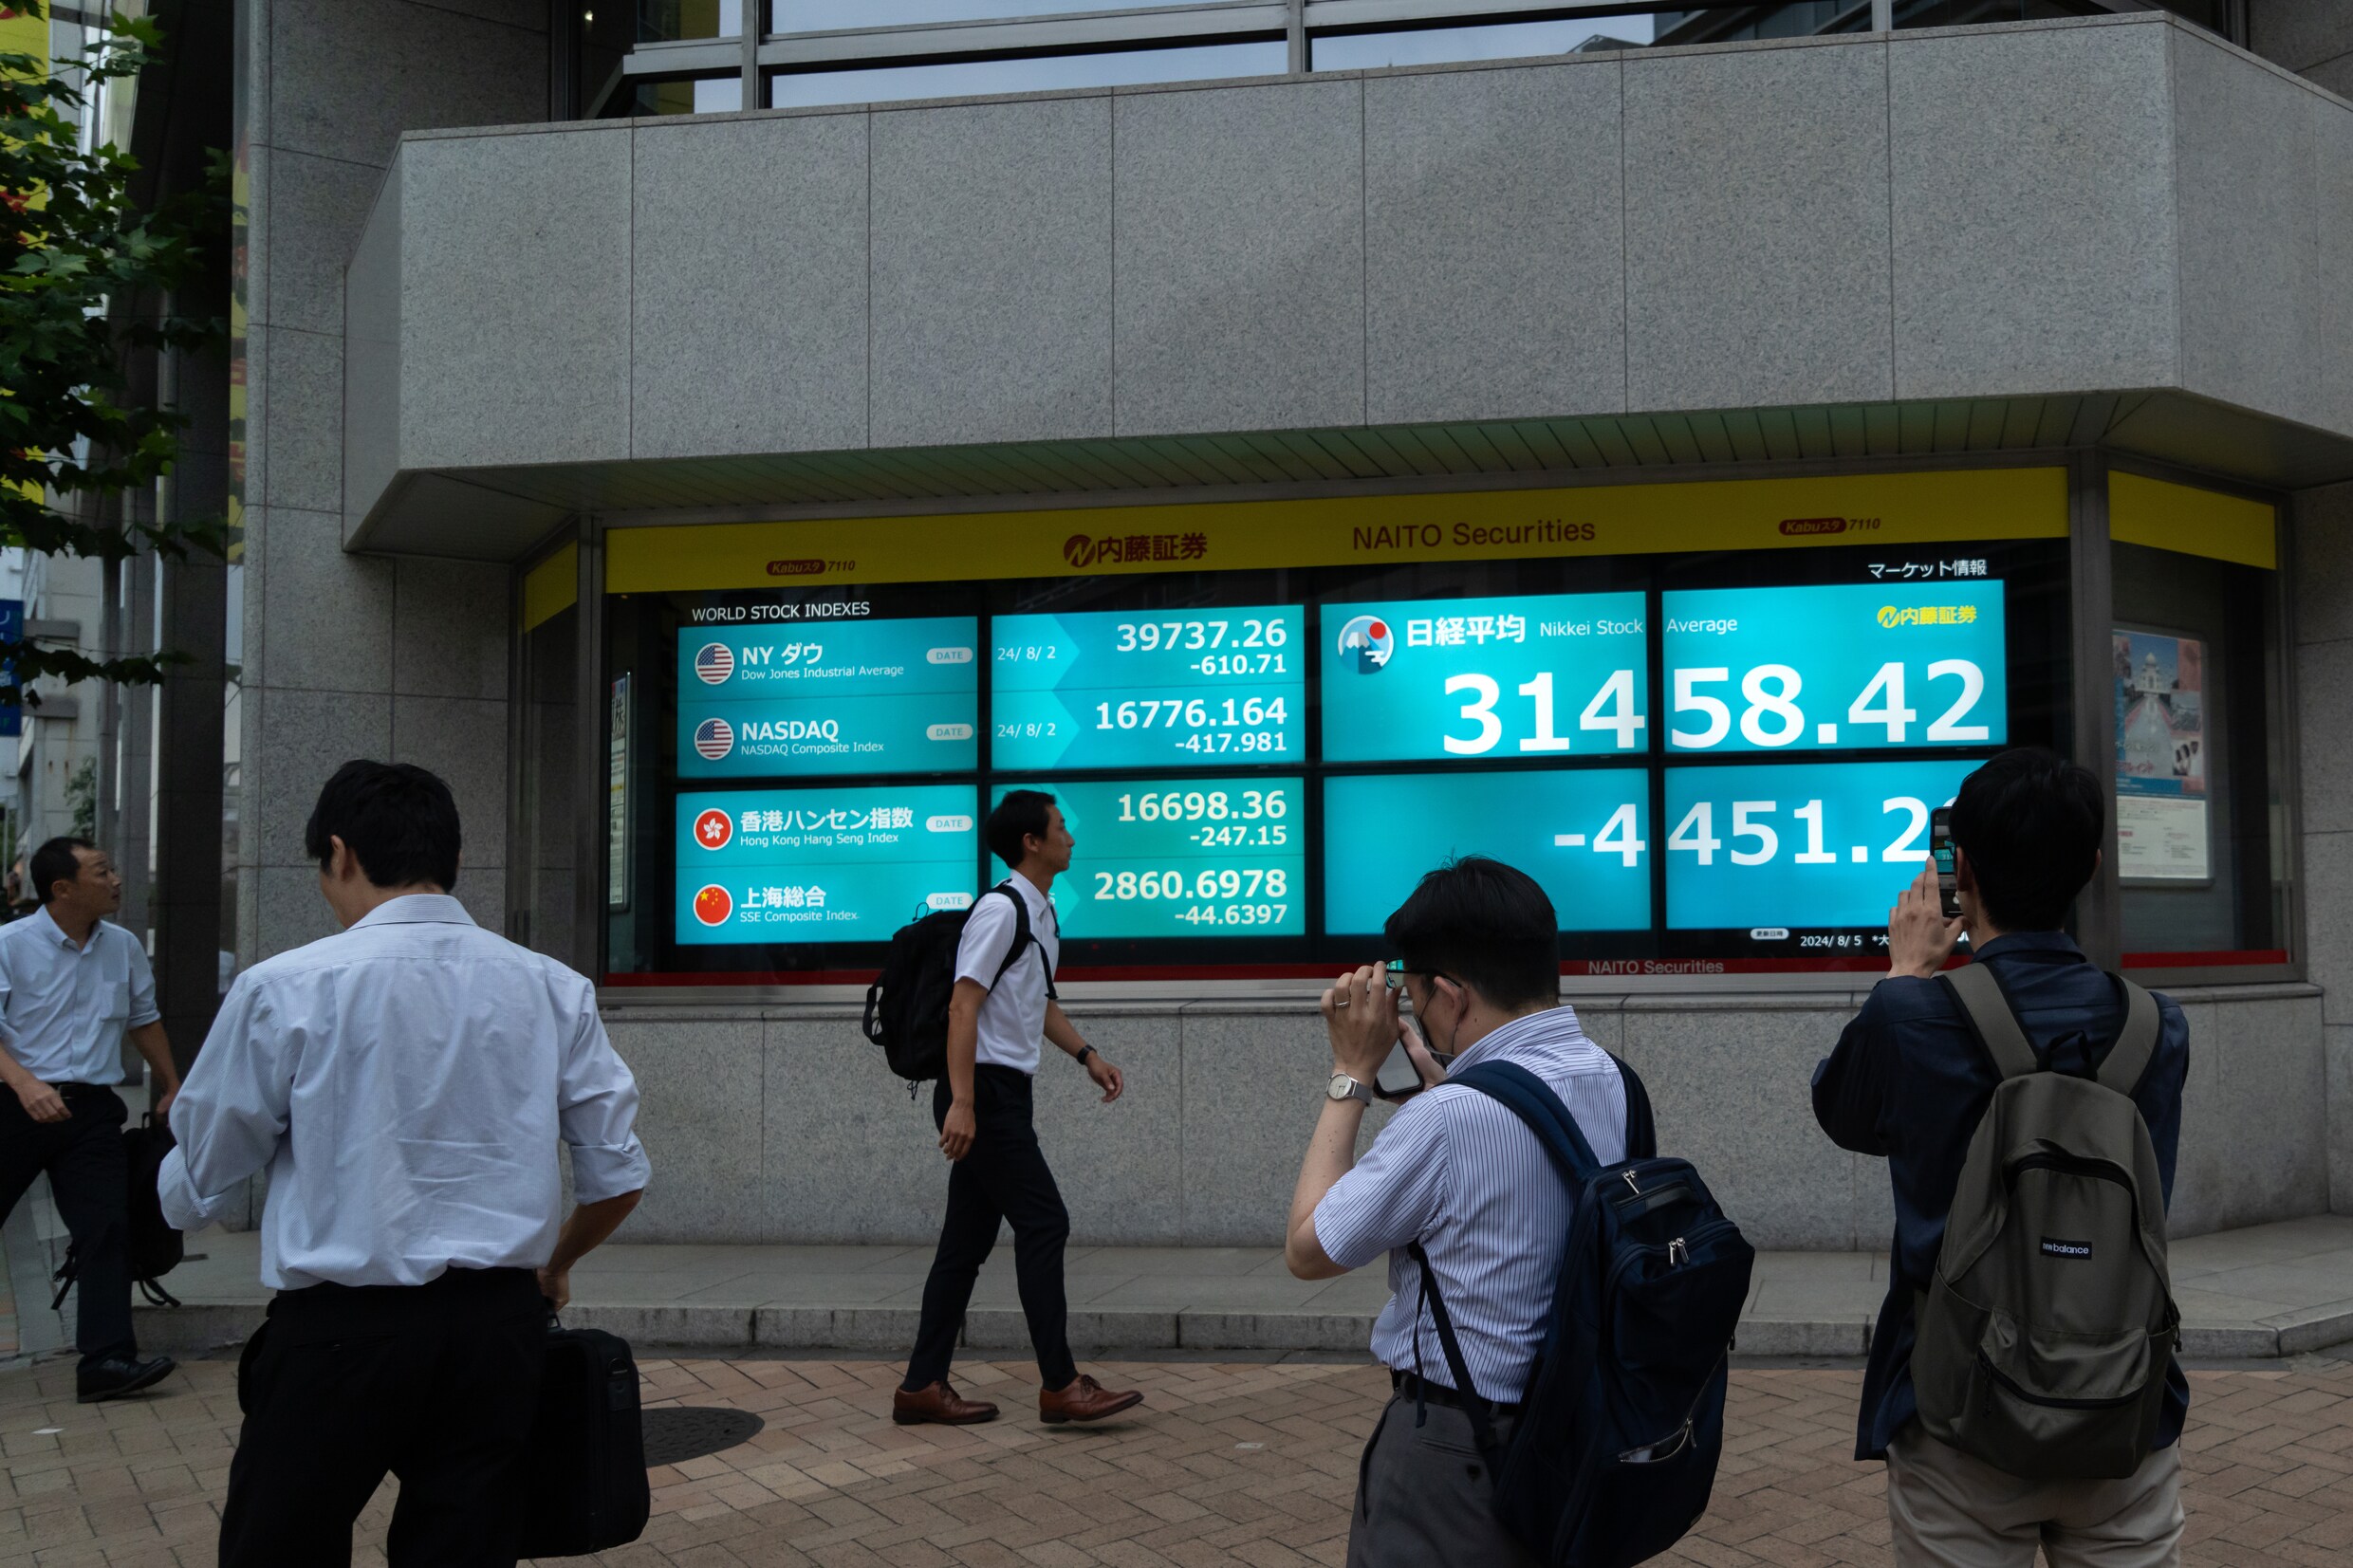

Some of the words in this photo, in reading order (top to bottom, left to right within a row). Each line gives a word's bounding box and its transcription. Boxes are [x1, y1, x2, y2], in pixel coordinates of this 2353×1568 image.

[1846, 518, 1881, 529] 7110
[1354, 525, 1441, 549] NAITO
[1454, 519, 1595, 545] Securities
[828, 561, 855, 571] 7110
[1868, 560, 1986, 578] マーケット情報
[693, 607, 746, 620] WORLD
[751, 605, 800, 618] STOCK
[806, 602, 869, 617] INDEXES
[1117, 618, 1288, 652] 39737.26
[1408, 615, 1525, 646] 日経平均
[1541, 622, 1589, 636] Nikkei
[1597, 619, 1642, 635] Stock
[1666, 619, 1738, 636] Average
[743, 647, 773, 665] NY
[782, 643, 822, 664] ダウ
[936, 652, 963, 660] DATE
[997, 647, 1022, 662] 24/
[1026, 647, 1042, 661] 8/
[1047, 646, 1056, 659] 2
[741, 669, 766, 680] Dow
[769, 669, 801, 679] Jones
[804, 667, 855, 678] Industrial
[858, 666, 904, 677] Average
[1191, 655, 1286, 674] -610.71
[1097, 697, 1287, 729] 16776.164
[743, 720, 838, 742] NASDAQ
[936, 728, 963, 737] DATE
[997, 724, 1022, 739] 24/
[1026, 724, 1043, 738] 8/
[1047, 723, 1056, 736] 2
[741, 744, 788, 757] NASDAQ
[791, 742, 849, 755] Composite
[853, 742, 884, 752] Index
[1176, 732, 1286, 752] -417.981
[1118, 790, 1287, 822] 16698.36
[741, 807, 913, 832] 香港ハンセン指数
[936, 820, 963, 828] DATE
[740, 836, 769, 848] Hong
[772, 836, 800, 847] Kong
[804, 835, 833, 847] Hang
[836, 833, 864, 846] Seng
[867, 833, 899, 843] Index
[1191, 825, 1286, 846] -247.15
[1554, 796, 1956, 867] -4451.2
[1095, 869, 1287, 899] 2860.6978
[741, 886, 825, 908] 上海総合
[936, 897, 963, 906] DATE
[739, 912, 761, 923] SSE
[764, 912, 823, 923] Composite
[825, 911, 858, 921] Index
[1176, 905, 1287, 924] -44.6397
[1800, 936, 1835, 948] 2024/
[1837, 936, 1850, 948] 8/
[1854, 935, 1862, 947] 5
[1589, 961, 1639, 974] NAITO
[1644, 960, 1725, 974] Securities
[2053, 1243, 2089, 1255] balance
